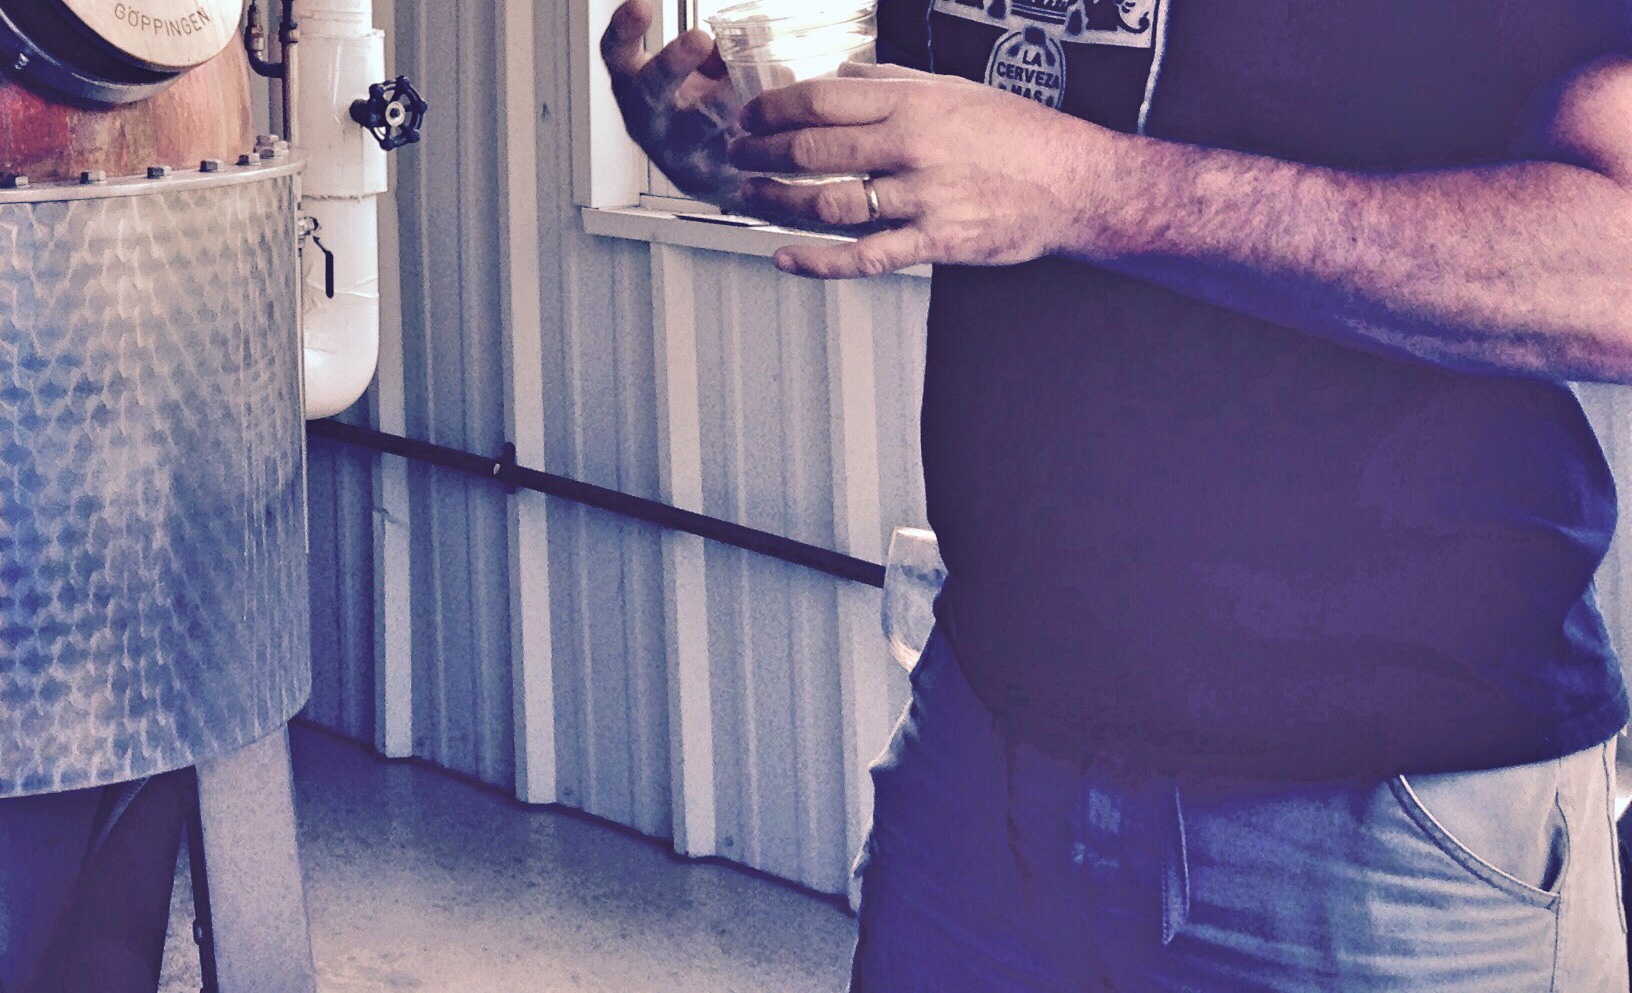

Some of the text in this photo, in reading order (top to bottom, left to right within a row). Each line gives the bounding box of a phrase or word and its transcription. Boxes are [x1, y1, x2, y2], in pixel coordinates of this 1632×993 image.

[114, 3, 210, 36] GÖPPINGEN
[1022, 50, 1042, 67] LA
[997, 61, 1060, 89] CERVEZA
